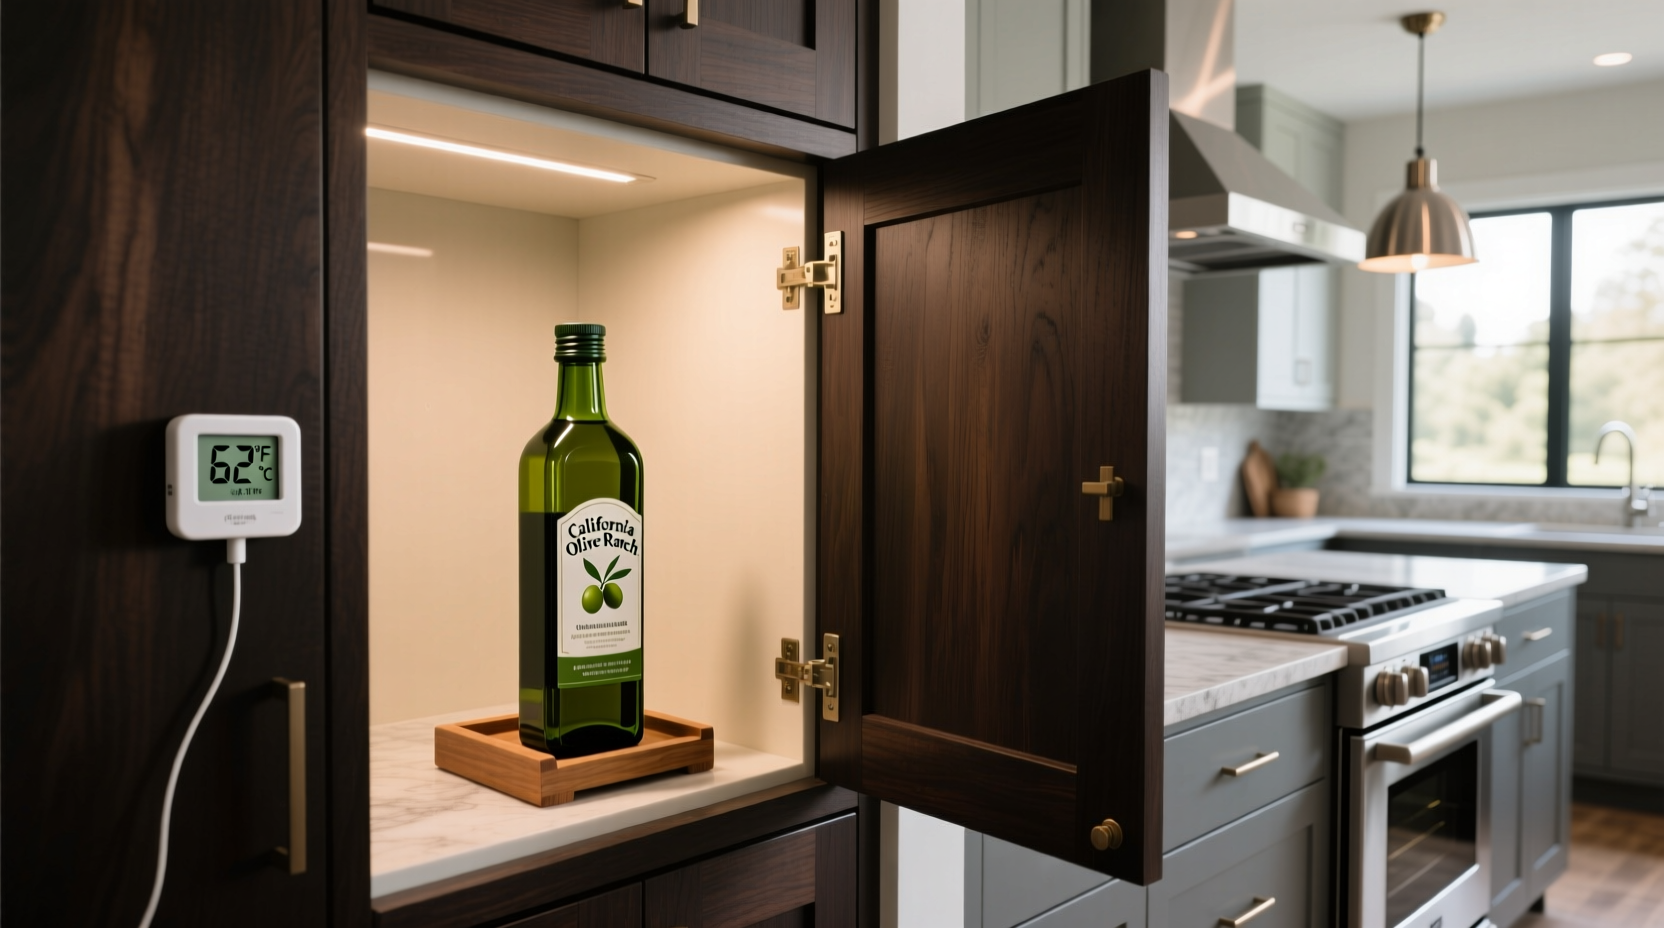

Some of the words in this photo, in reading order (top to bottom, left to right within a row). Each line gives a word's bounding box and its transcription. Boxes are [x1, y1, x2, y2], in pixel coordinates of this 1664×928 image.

[210, 444, 254, 484] 62
[258, 465, 273, 481] °C
[568, 515, 635, 538] California
